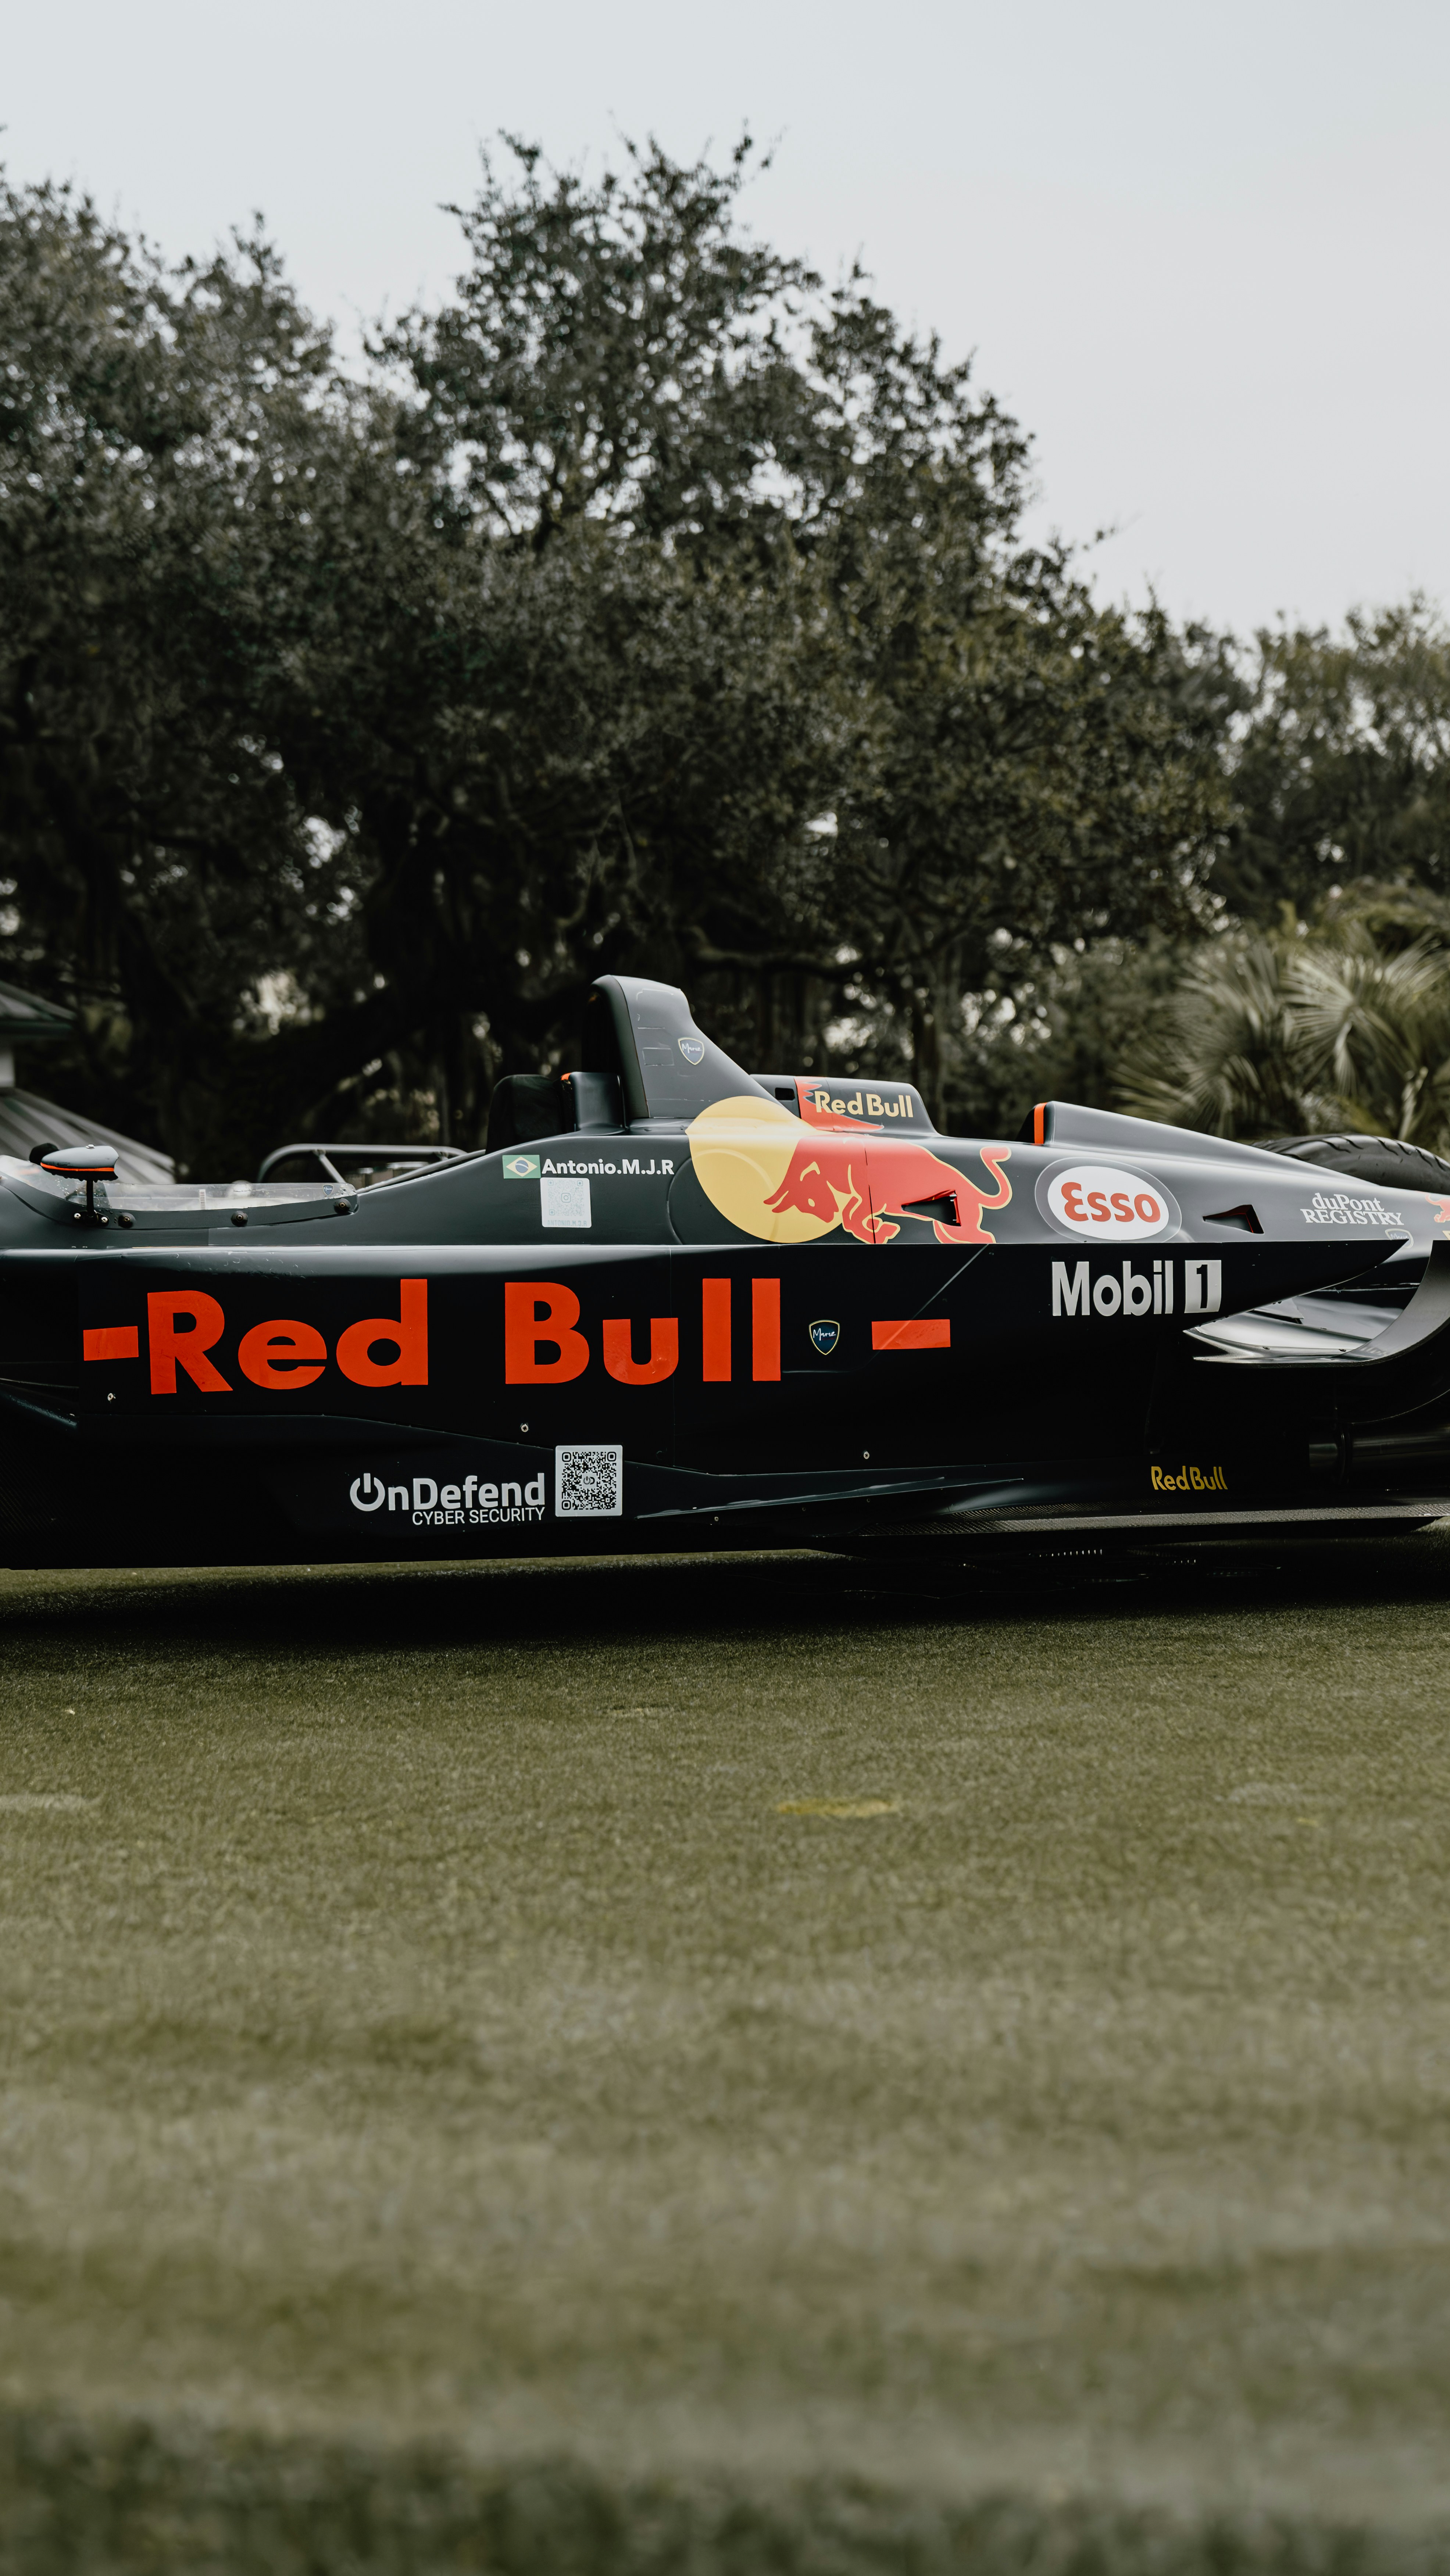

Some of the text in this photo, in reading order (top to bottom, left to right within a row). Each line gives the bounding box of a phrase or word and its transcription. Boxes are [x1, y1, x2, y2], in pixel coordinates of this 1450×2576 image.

[542, 1159, 674, 1175] Antonio.M.J.R
[1061, 1182, 1161, 1223] Esso
[1312, 1192, 1385, 1212] duPont
[1300, 1209, 1404, 1225] REGISTRY
[1052, 1260, 1174, 1316] Mobil
[147, 1278, 781, 1395] Red Bull
[350, 1473, 545, 1511] OnDefend
[412, 1507, 545, 1525] CYBER SECURITY
